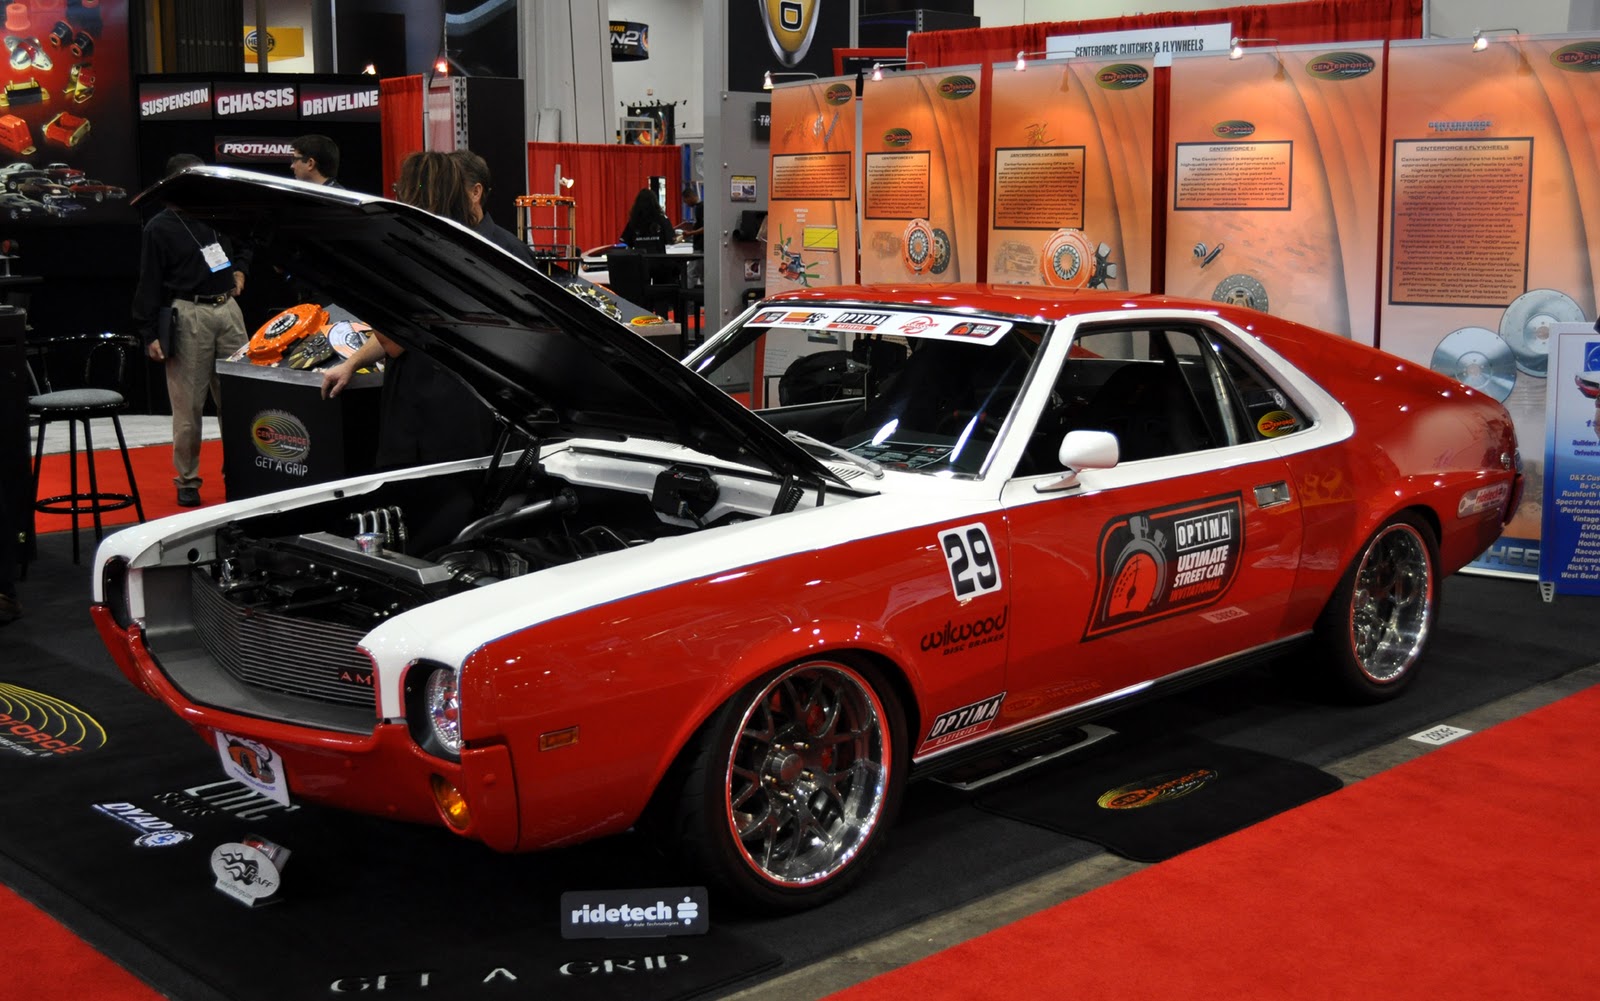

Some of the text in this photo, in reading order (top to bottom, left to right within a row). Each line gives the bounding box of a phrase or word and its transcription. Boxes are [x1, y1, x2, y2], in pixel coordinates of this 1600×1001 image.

[248, 37, 275, 46] HEA
[1075, 38, 1204, 58] CENTERFORCE CLUTCHES & FLYWHEELS
[1099, 72, 1147, 80] CENTERFORCE
[1311, 62, 1374, 70] CENTERFORCE
[142, 87, 209, 117] SUSPENSION
[217, 87, 295, 116] CHASSIS
[303, 89, 379, 117] DRIVELINE
[223, 143, 295, 154] PROTHANE
[834, 312, 890, 327] OPTIMA
[257, 430, 308, 445] CENTERFORCE
[255, 456, 308, 477] GET A GRIP
[1562, 490, 1597, 498] Rushforth
[1573, 515, 1600, 523] Vintage
[1178, 516, 1229, 546] OPTIMA
[943, 527, 997, 597] 29
[1177, 544, 1229, 573] ULTIMATE
[1567, 563, 1589, 571] Rick's
[1173, 562, 1225, 588] STREET CAR
[1169, 578, 1221, 602] INVITATIONAL
[920, 605, 1008, 651] wilwood
[943, 633, 1005, 656] DISC BRAKES
[341, 671, 375, 686] AM
[931, 699, 1000, 738] OPTIMA
[936, 725, 978, 745] BATTERIES
[102, 802, 174, 829] DYAD
[571, 901, 672, 923] ridetech
[646, 920, 679, 928] Technologies
[483, 967, 518, 983] A
[559, 954, 689, 976] GRIP
